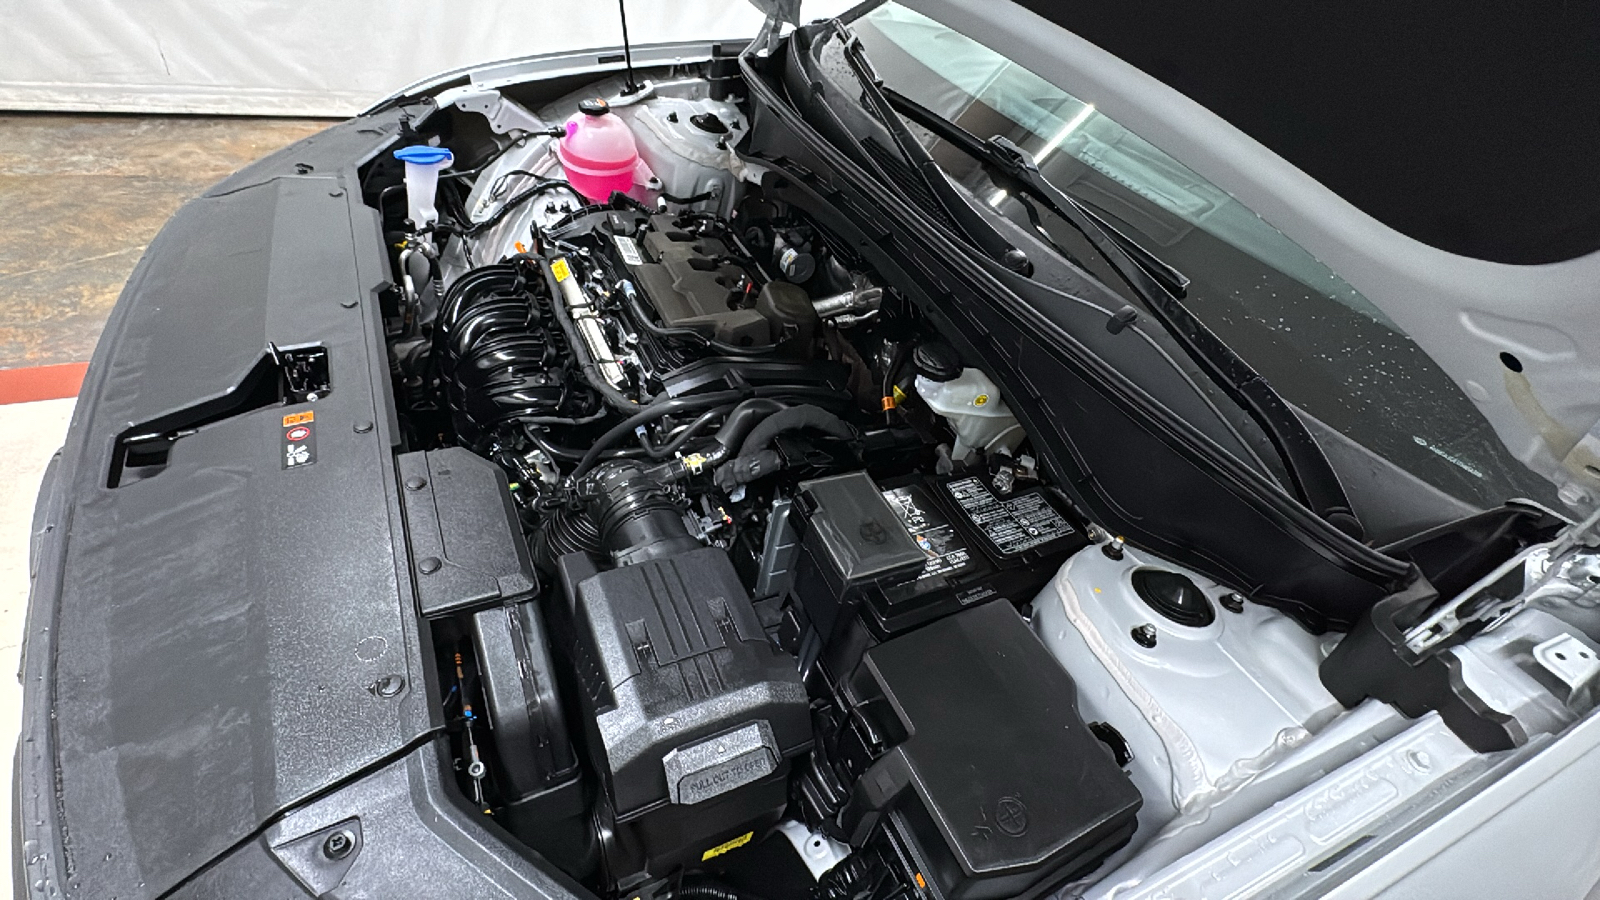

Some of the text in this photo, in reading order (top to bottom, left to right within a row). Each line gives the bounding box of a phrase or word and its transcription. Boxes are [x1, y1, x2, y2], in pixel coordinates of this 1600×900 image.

[690, 758, 767, 793] PULL OUT TO OPEN
